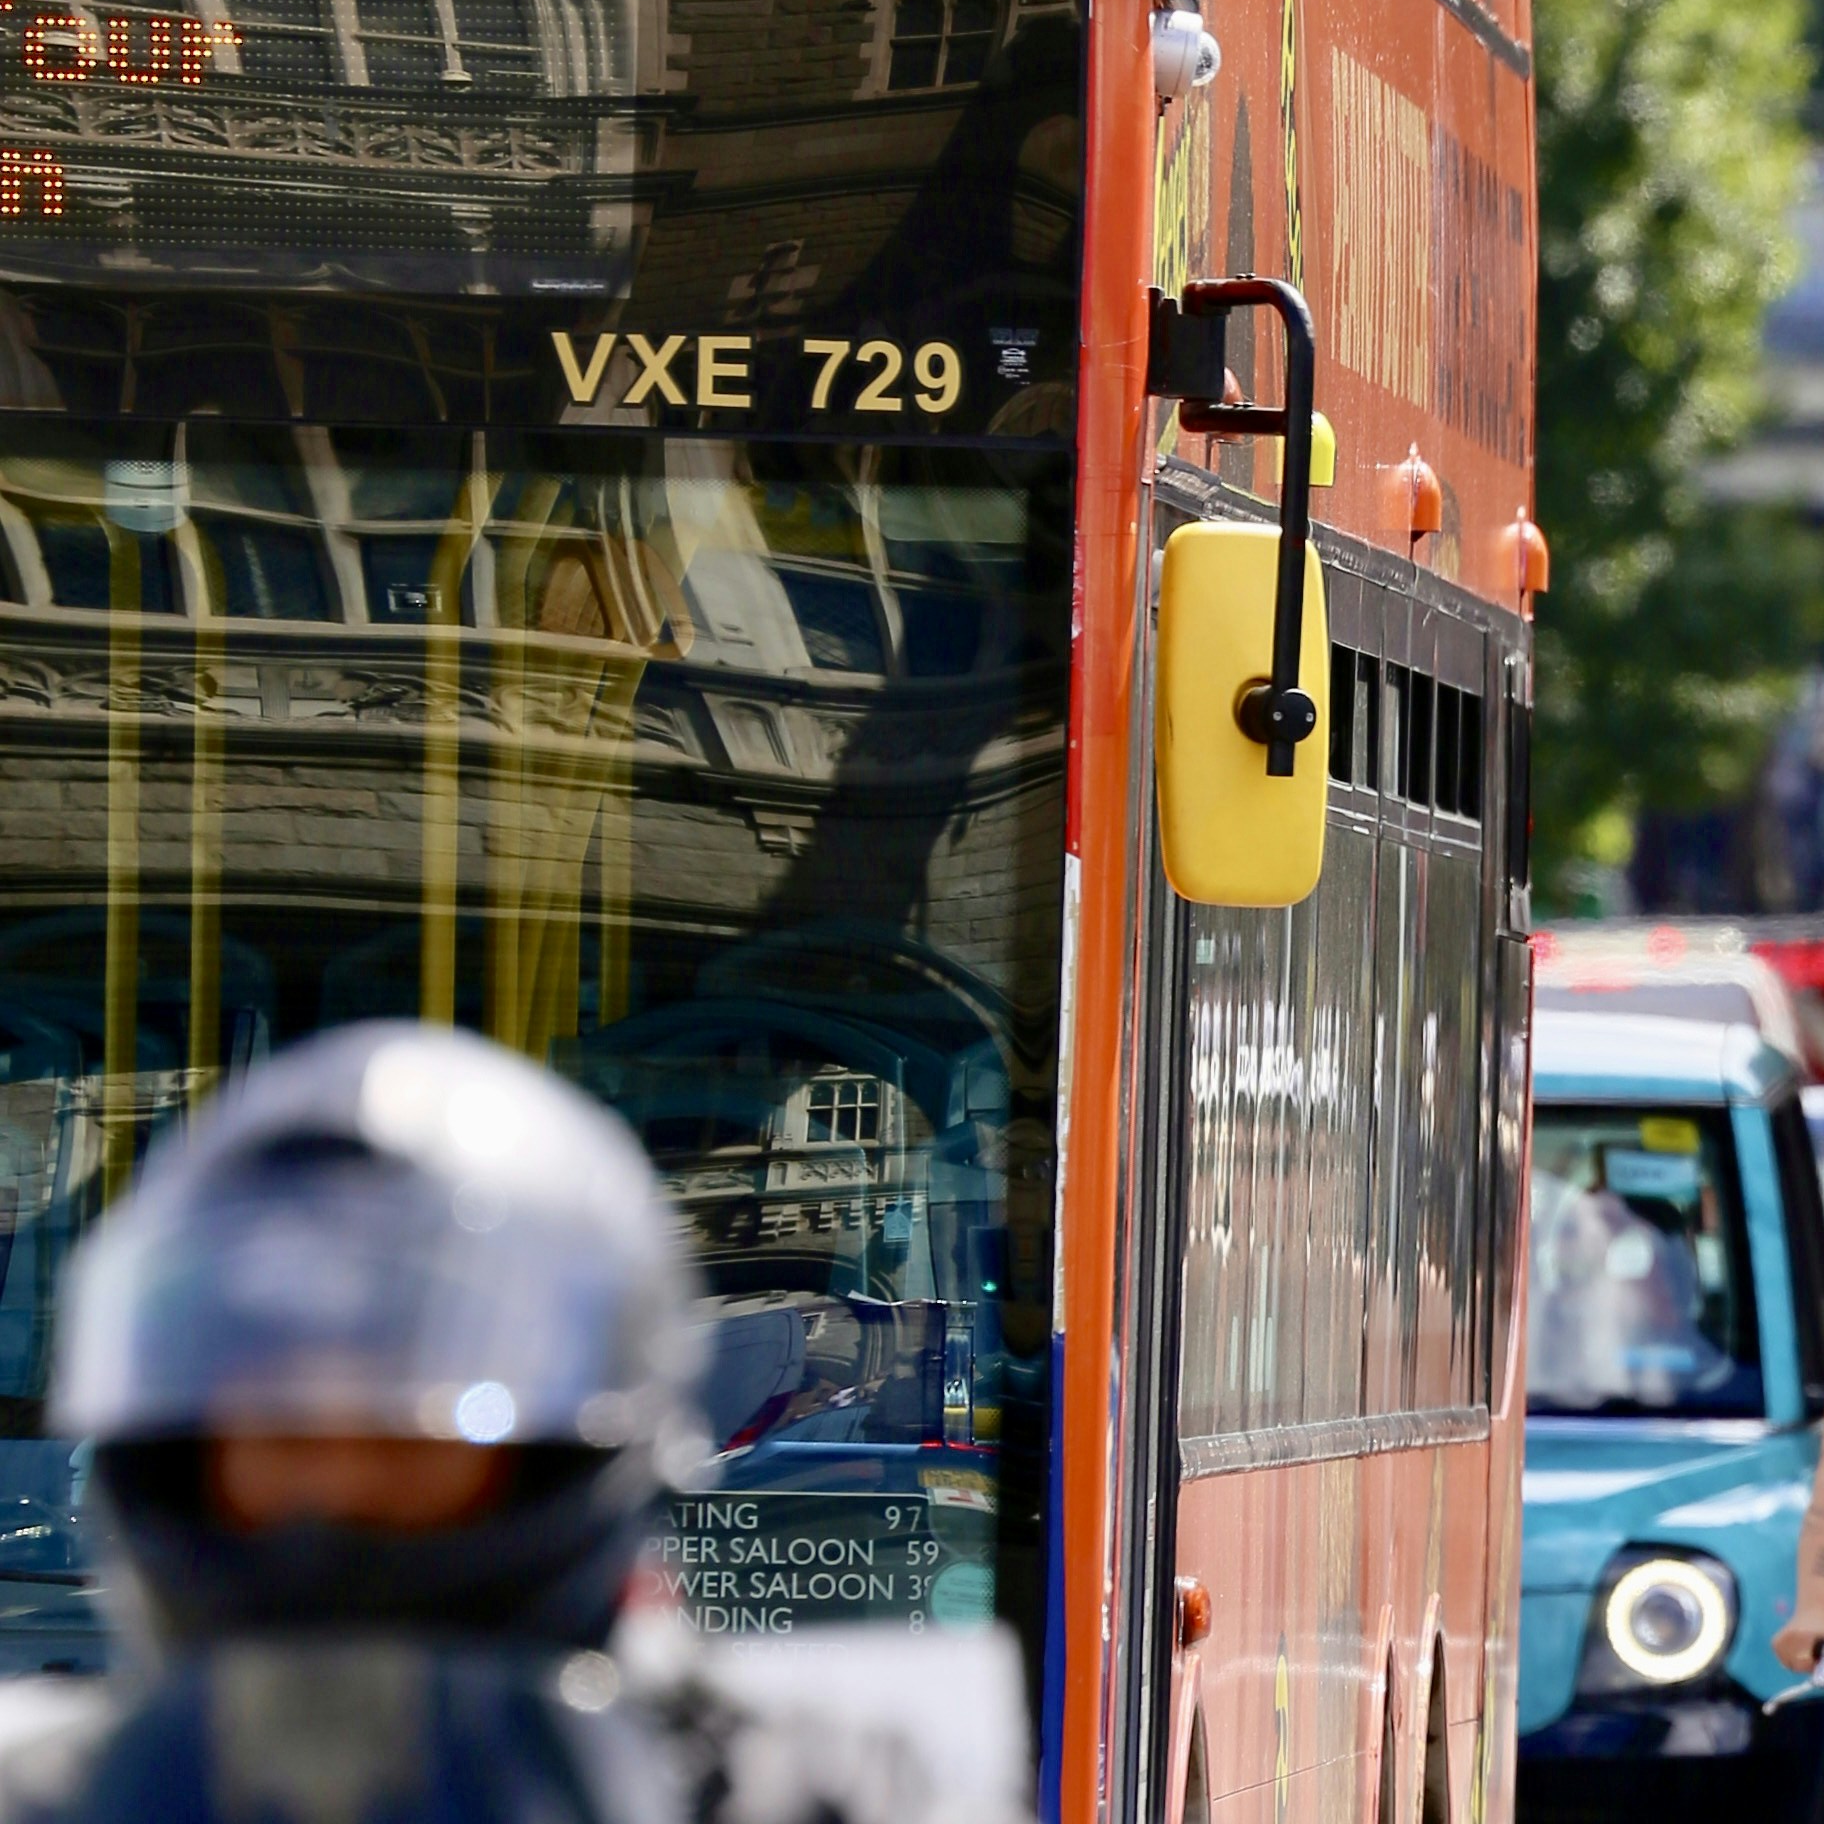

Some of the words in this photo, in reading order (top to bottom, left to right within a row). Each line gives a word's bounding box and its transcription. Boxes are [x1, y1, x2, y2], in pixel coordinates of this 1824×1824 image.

[551, 330, 753, 409] VXE
[803, 339, 963, 414] 729
[884, 1505, 922, 1532] 97
[646, 1536, 721, 1564] PPER
[729, 1537, 874, 1566] SALOON
[905, 1540, 939, 1566] 59
[749, 1572, 894, 1601] SALOON
[909, 1610, 925, 1636] 8
